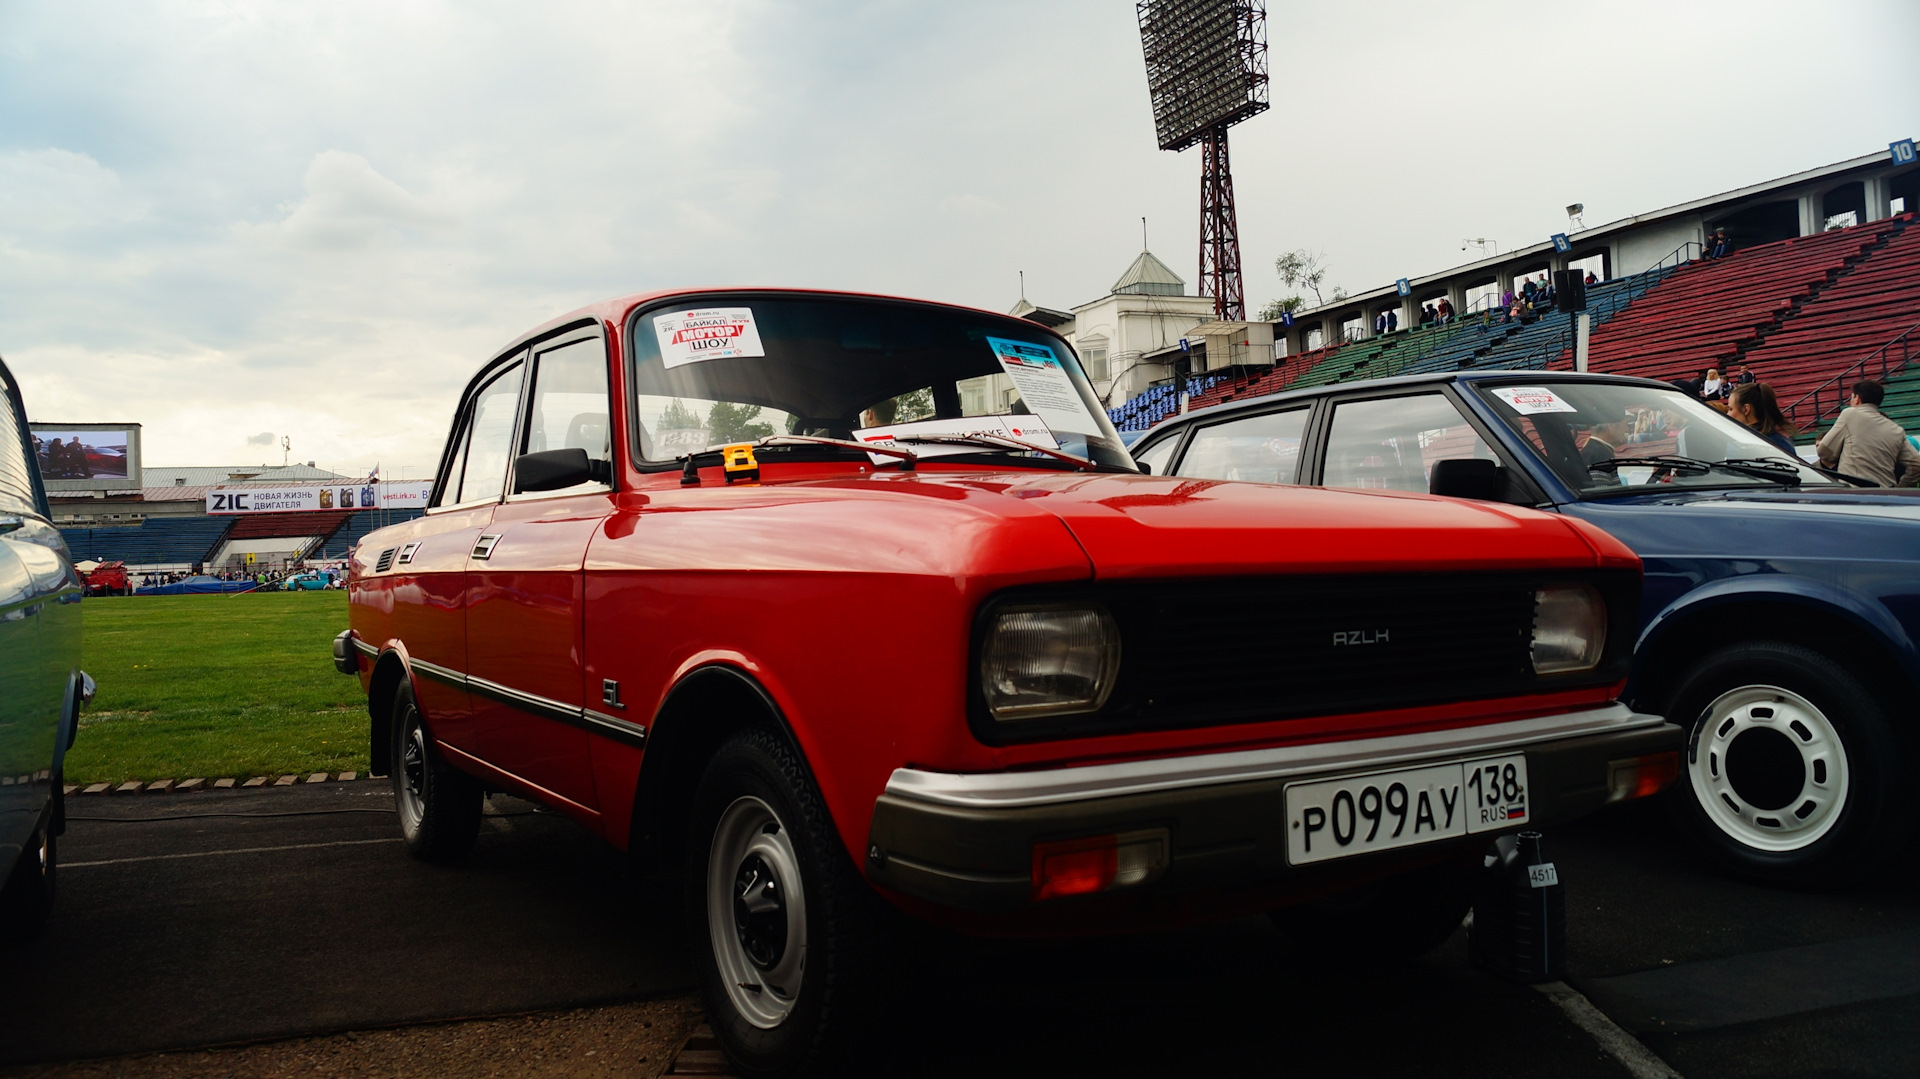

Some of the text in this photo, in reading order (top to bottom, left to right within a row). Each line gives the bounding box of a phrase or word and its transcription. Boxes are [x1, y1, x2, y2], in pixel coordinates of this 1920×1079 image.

[1893, 142, 1913, 162] 10
[1556, 236, 1567, 251] 9
[1400, 281, 1407, 293] 8
[685, 319, 726, 328] БАЙКАЛ
[1284, 313, 1290, 325] 7
[681, 327, 736, 341] МОТОР
[692, 338, 728, 350] ШОУ
[211, 494, 250, 510] ZIC
[254, 491, 313, 500] НОВАЯ ЖИЗНЬ
[383, 492, 417, 500] vesti.irk.ru
[254, 501, 301, 510] ДВИГАТЕЛЯ
[1333, 629, 1389, 646] AZLH
[1468, 763, 1518, 808] 138
[1481, 808, 1507, 823] RUS
[1531, 867, 1555, 882] 4517
